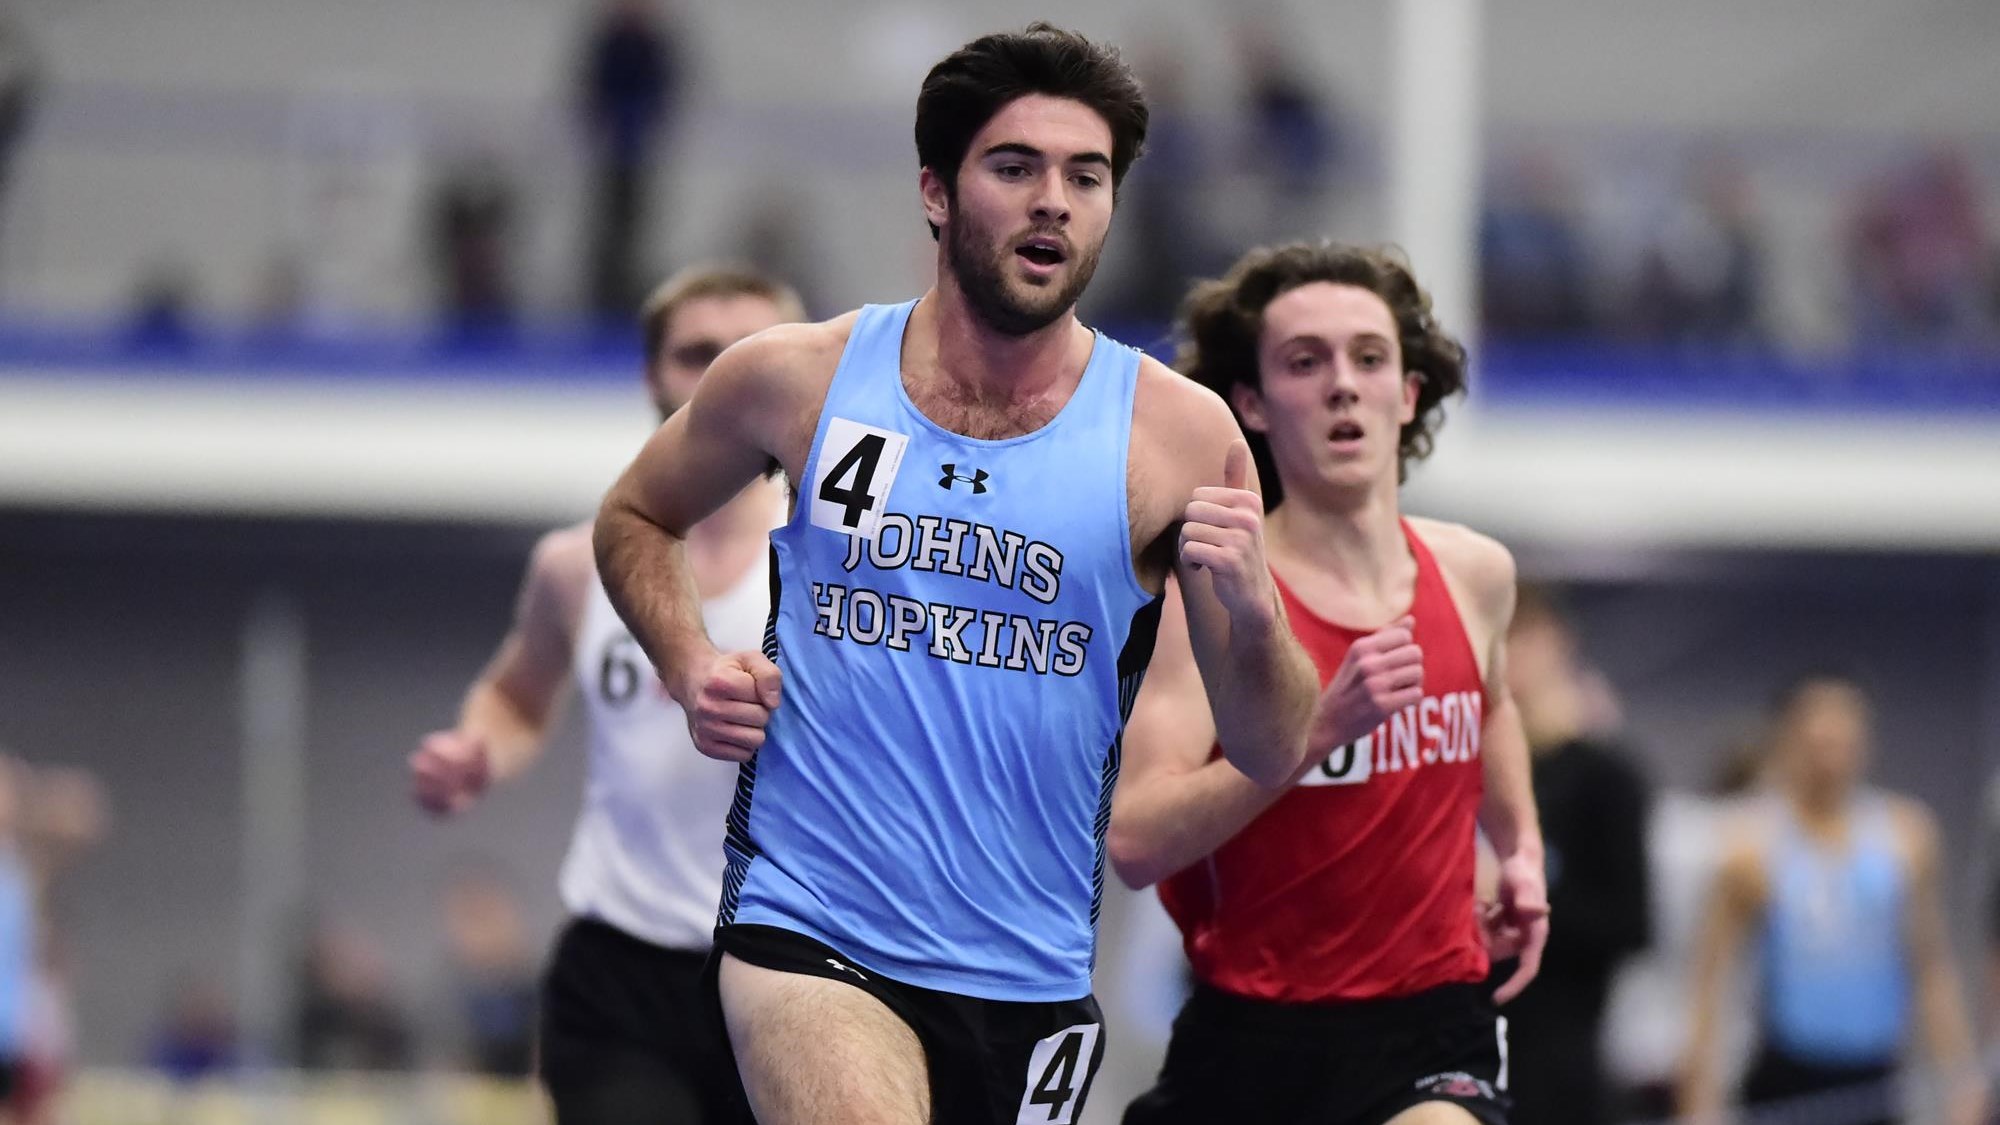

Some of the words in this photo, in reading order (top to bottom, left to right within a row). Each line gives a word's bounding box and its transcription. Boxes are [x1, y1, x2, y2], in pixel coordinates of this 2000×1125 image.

[818, 433, 887, 529] 4
[842, 513, 1064, 604] JOHNS
[600, 630, 640, 710] 6
[812, 581, 1094, 677] HOPKINS
[1029, 1032, 1084, 1121] 4
